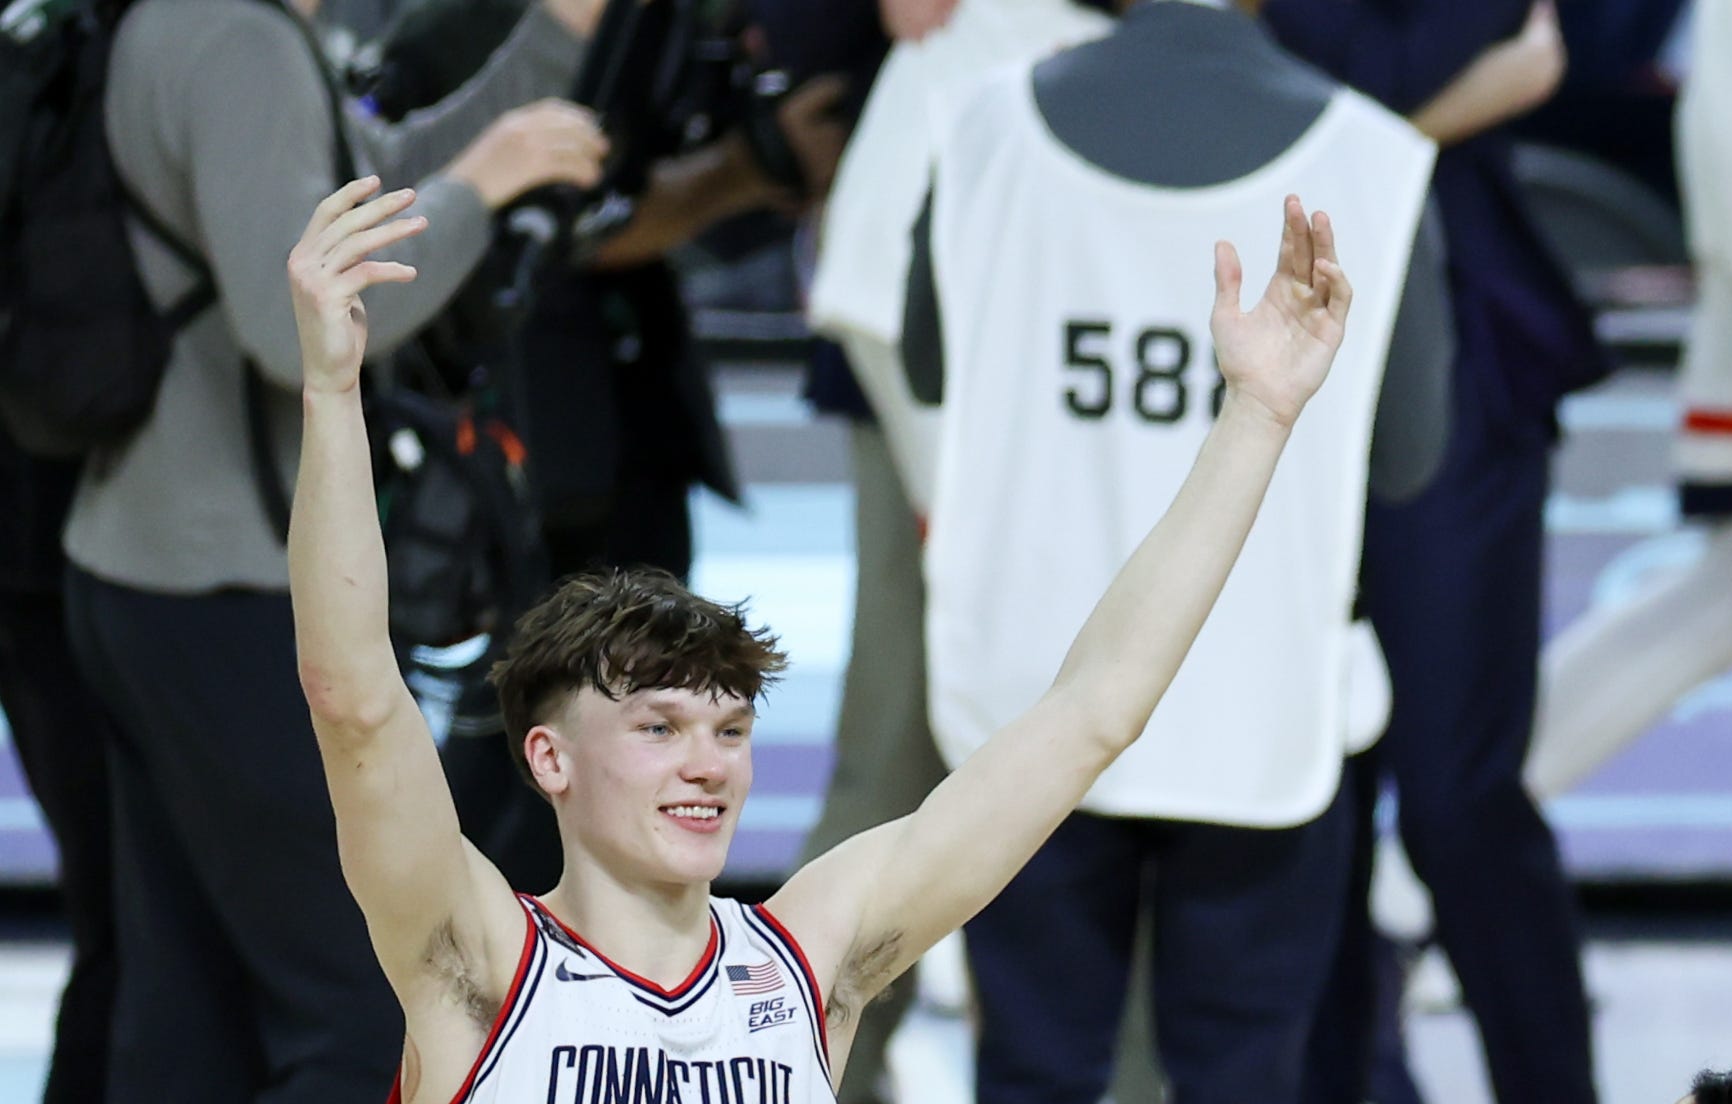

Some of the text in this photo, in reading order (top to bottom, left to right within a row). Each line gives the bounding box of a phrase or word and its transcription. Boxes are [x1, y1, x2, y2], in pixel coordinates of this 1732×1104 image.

[1064, 320, 1228, 424] 58
[748, 1006, 798, 1027] EAST
[749, 996, 785, 1016] BIG
